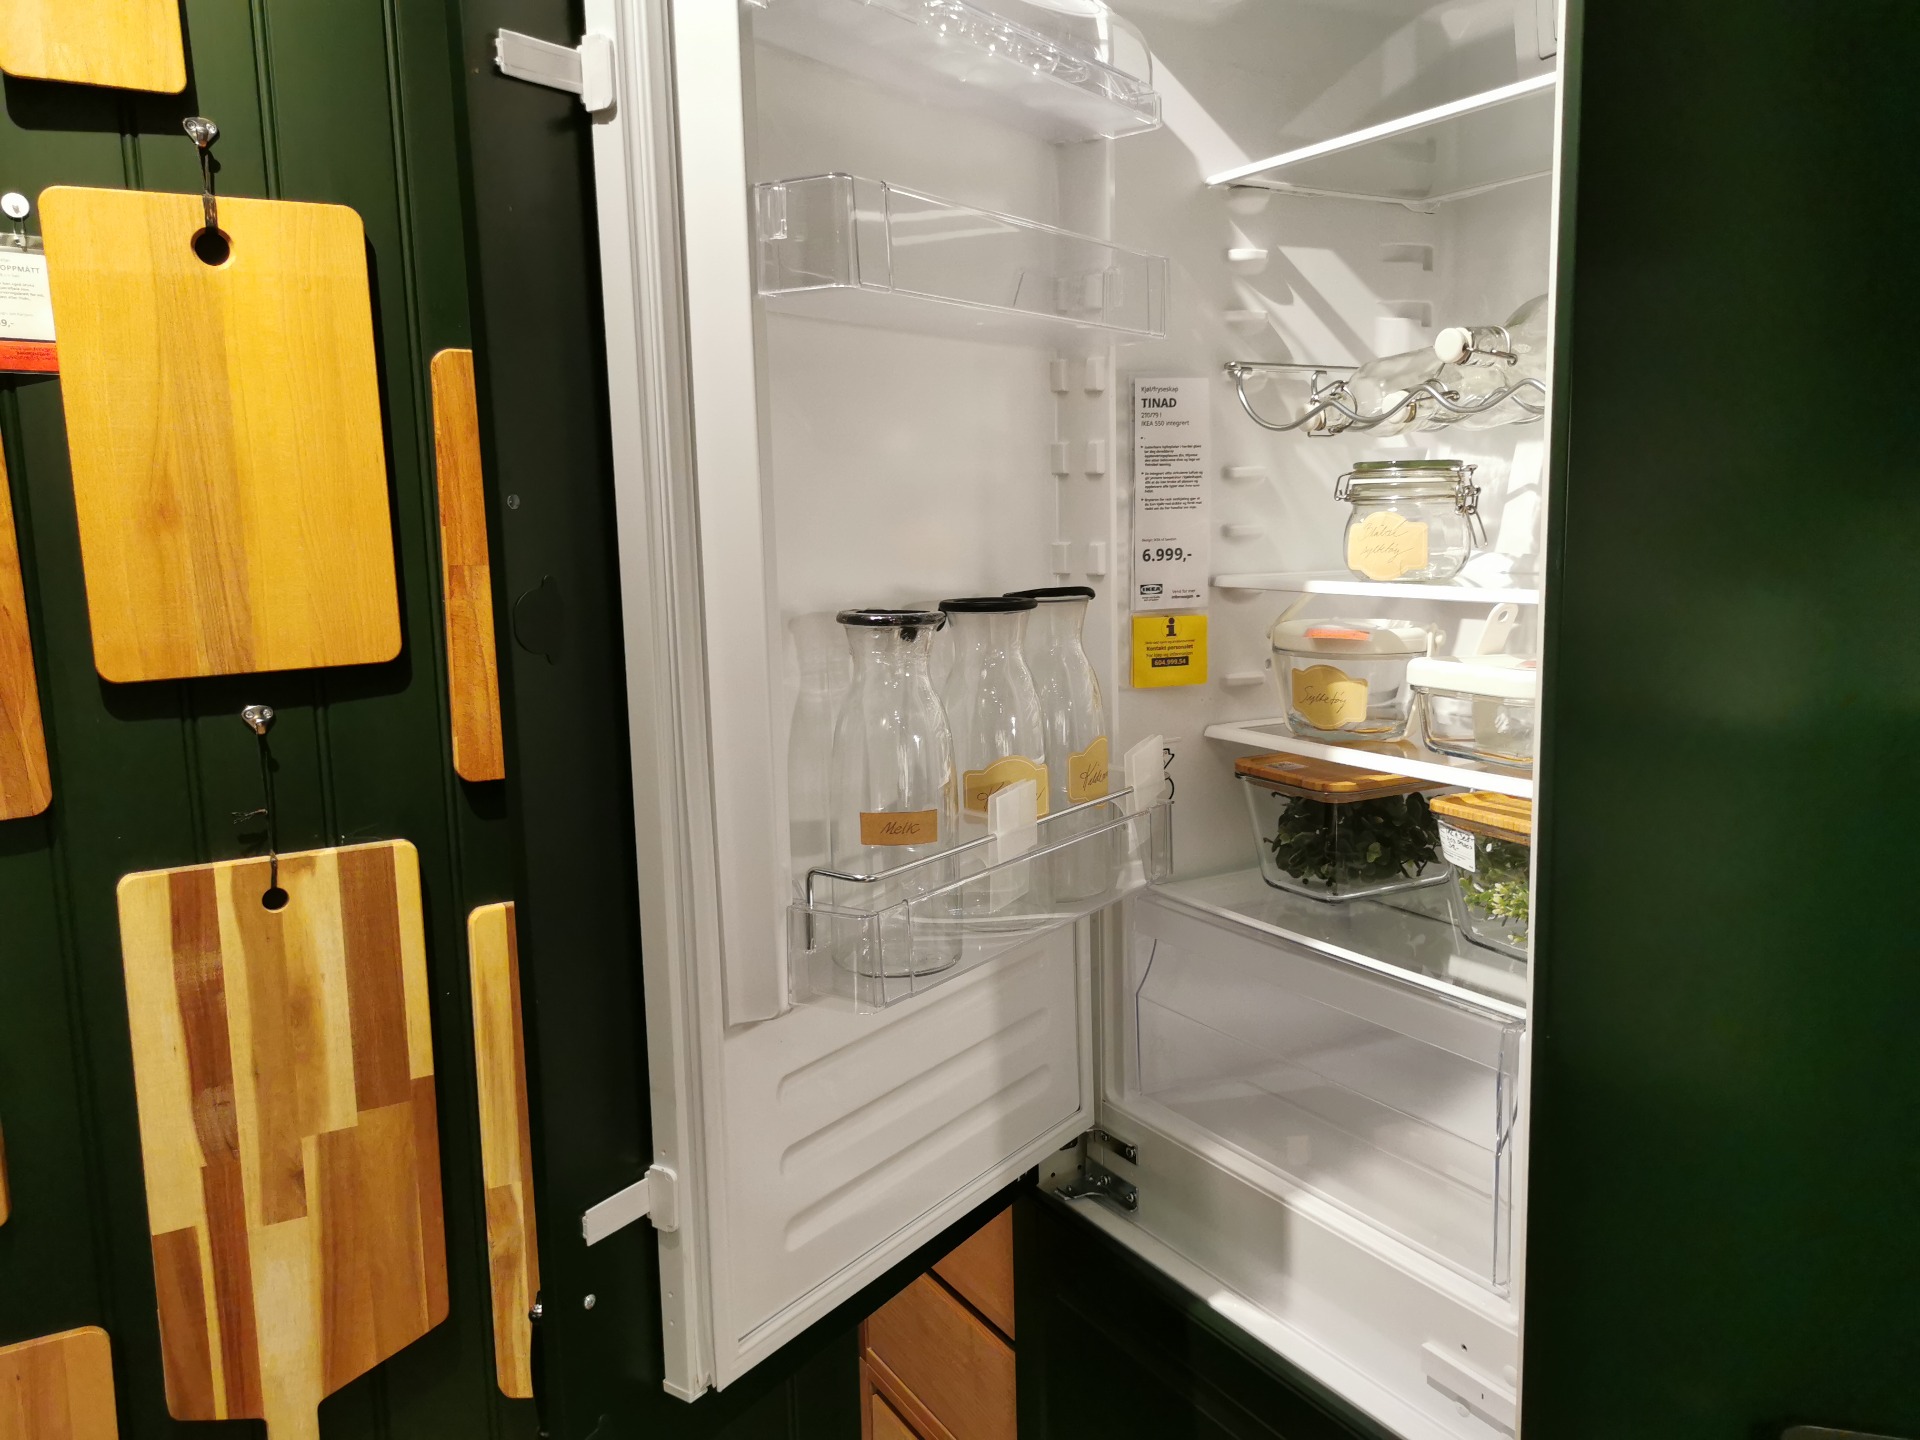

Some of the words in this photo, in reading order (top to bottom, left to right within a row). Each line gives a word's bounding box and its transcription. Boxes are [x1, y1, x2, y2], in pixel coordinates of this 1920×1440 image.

[0, 319, 15, 328] 9,-
[1141, 397, 1177, 408] TINAD
[1142, 547, 1192, 563] 6.999,-
